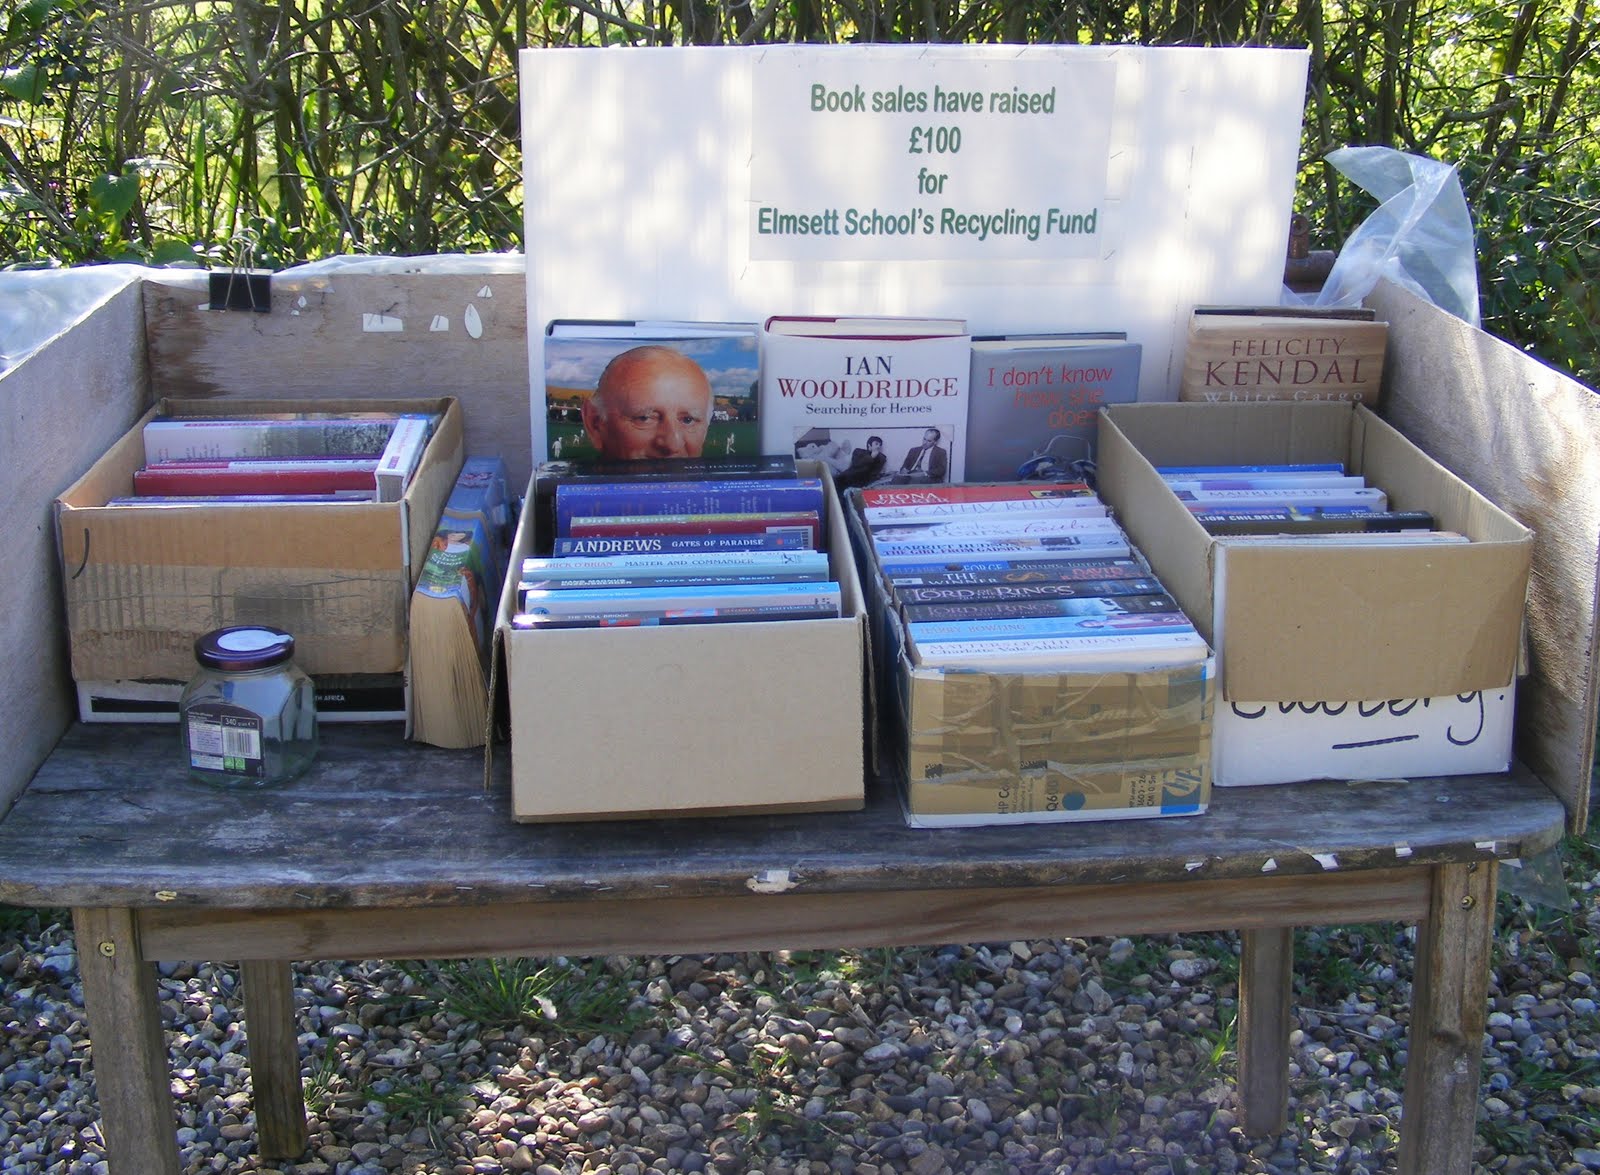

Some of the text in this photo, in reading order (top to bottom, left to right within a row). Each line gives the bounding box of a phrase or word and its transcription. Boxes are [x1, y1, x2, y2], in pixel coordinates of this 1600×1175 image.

[811, 84, 1056, 114] Book sales have raised
[908, 126, 962, 154] £100
[917, 168, 948, 195] for
[758, 208, 1098, 241] Elmsett School's Recycling Fund
[1231, 338, 1346, 356] FELICITY
[844, 355, 893, 376] IAN
[1205, 359, 1367, 386] KENDAL
[987, 364, 1113, 386] I don't know
[777, 377, 958, 399] WOOLDRIDGE
[1014, 384, 1104, 408] how she
[1294, 390, 1363, 402] Cargo
[806, 403, 932, 417] Searching for Heroes
[871, 497, 950, 506] WALKER
[878, 492, 938, 501] FIONA
[573, 539, 662, 553] ANDREWS
[671, 540, 701, 548] GATES
[720, 539, 764, 547] PARADISE
[891, 541, 1018, 551] HARRIET HUDSON
[940, 547, 974, 555] FROM
[430, 556, 462, 566] Spoon
[433, 553, 463, 562] Silver
[624, 560, 664, 568] MASTER
[692, 558, 754, 566] COMMANDER
[963, 563, 1003, 572] EORGE
[1072, 566, 1124, 575] DAVID
[928, 578, 998, 586] WINNER
[943, 572, 978, 580] THE
[911, 588, 975, 601] LORD
[993, 585, 1075, 596] RINGS
[927, 605, 978, 617] LORD
[995, 603, 1058, 613] RINGS
[967, 624, 1026, 634] BOWLING
[929, 641, 1010, 650] MATTERS
[1080, 636, 1137, 644] HEART
[930, 647, 991, 655] Charlotte
[225, 717, 237, 726] 340
[998, 800, 1009, 815] HP
